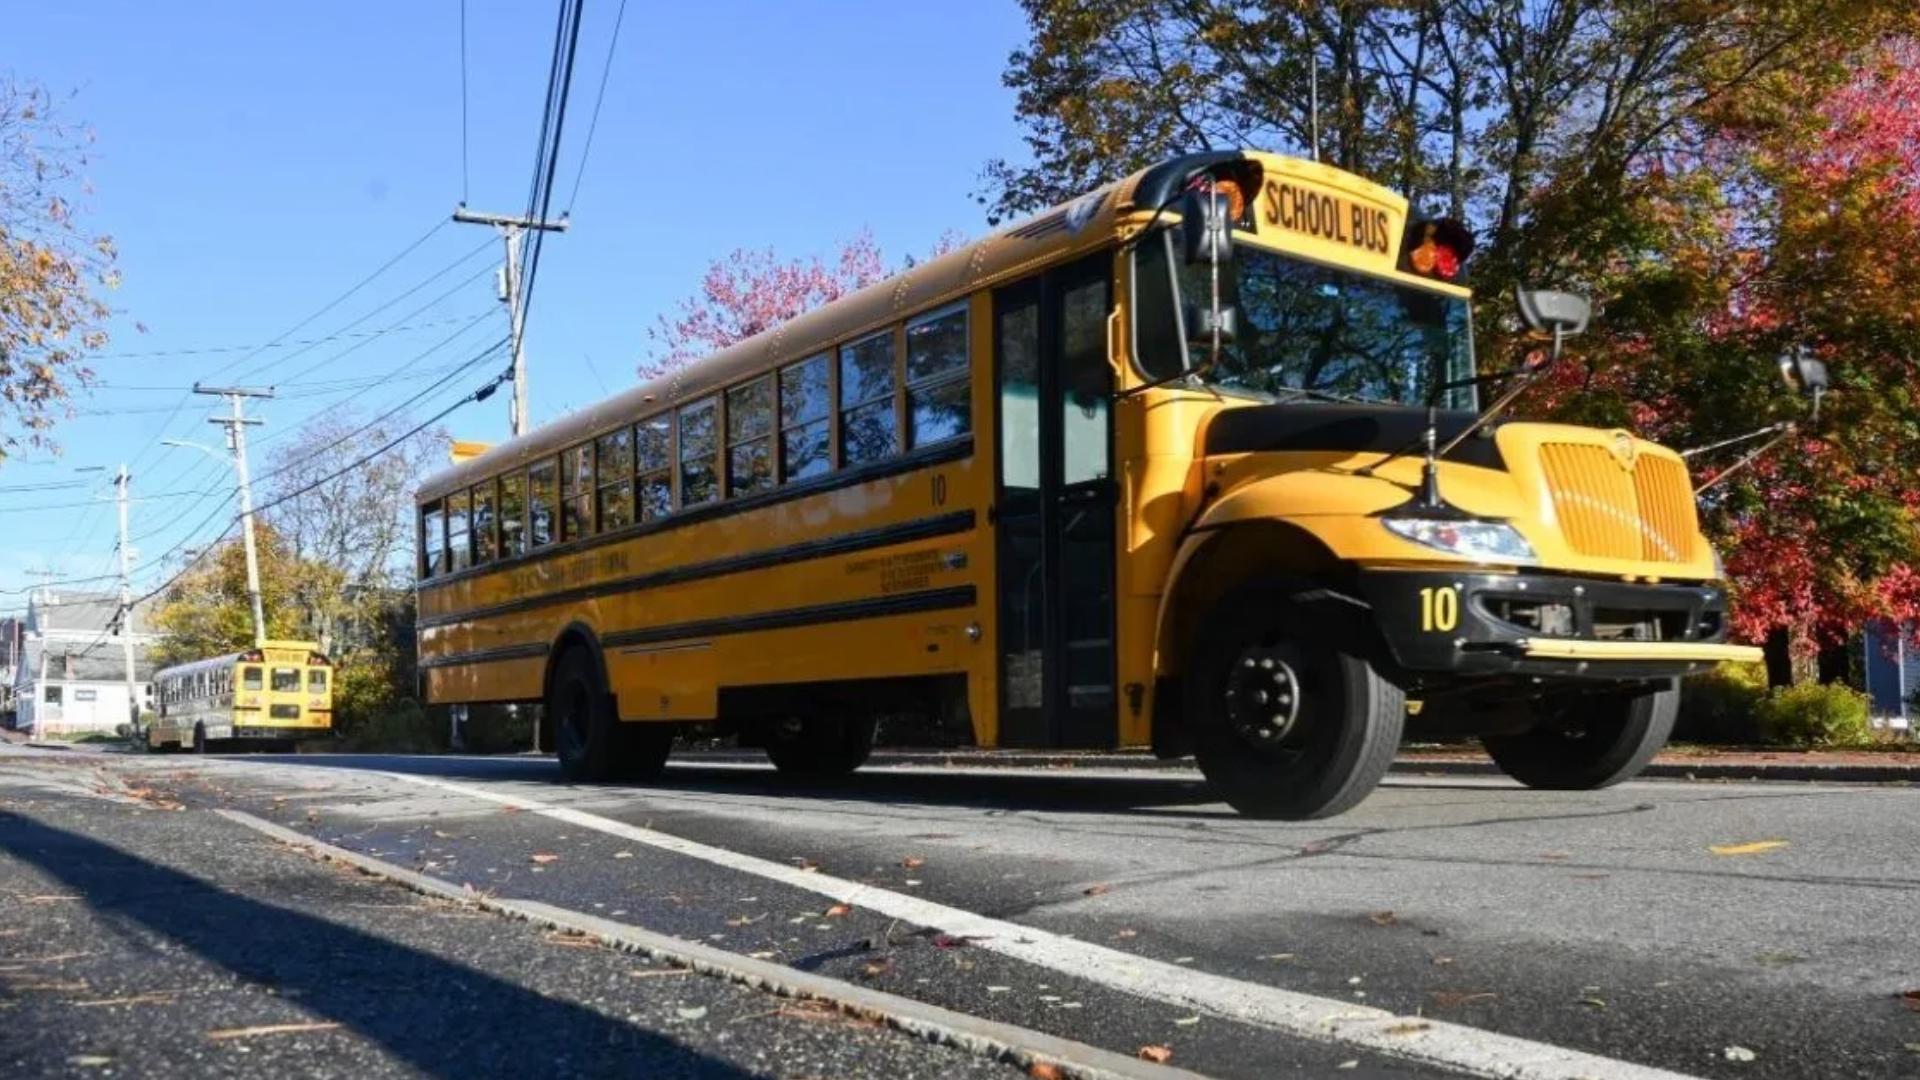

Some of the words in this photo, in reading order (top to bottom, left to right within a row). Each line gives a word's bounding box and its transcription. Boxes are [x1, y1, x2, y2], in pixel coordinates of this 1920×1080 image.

[1266, 180, 1347, 242] SCHOOL
[1352, 204, 1388, 253] BUS
[931, 474, 946, 506] 10
[1420, 587, 1457, 632] 10
